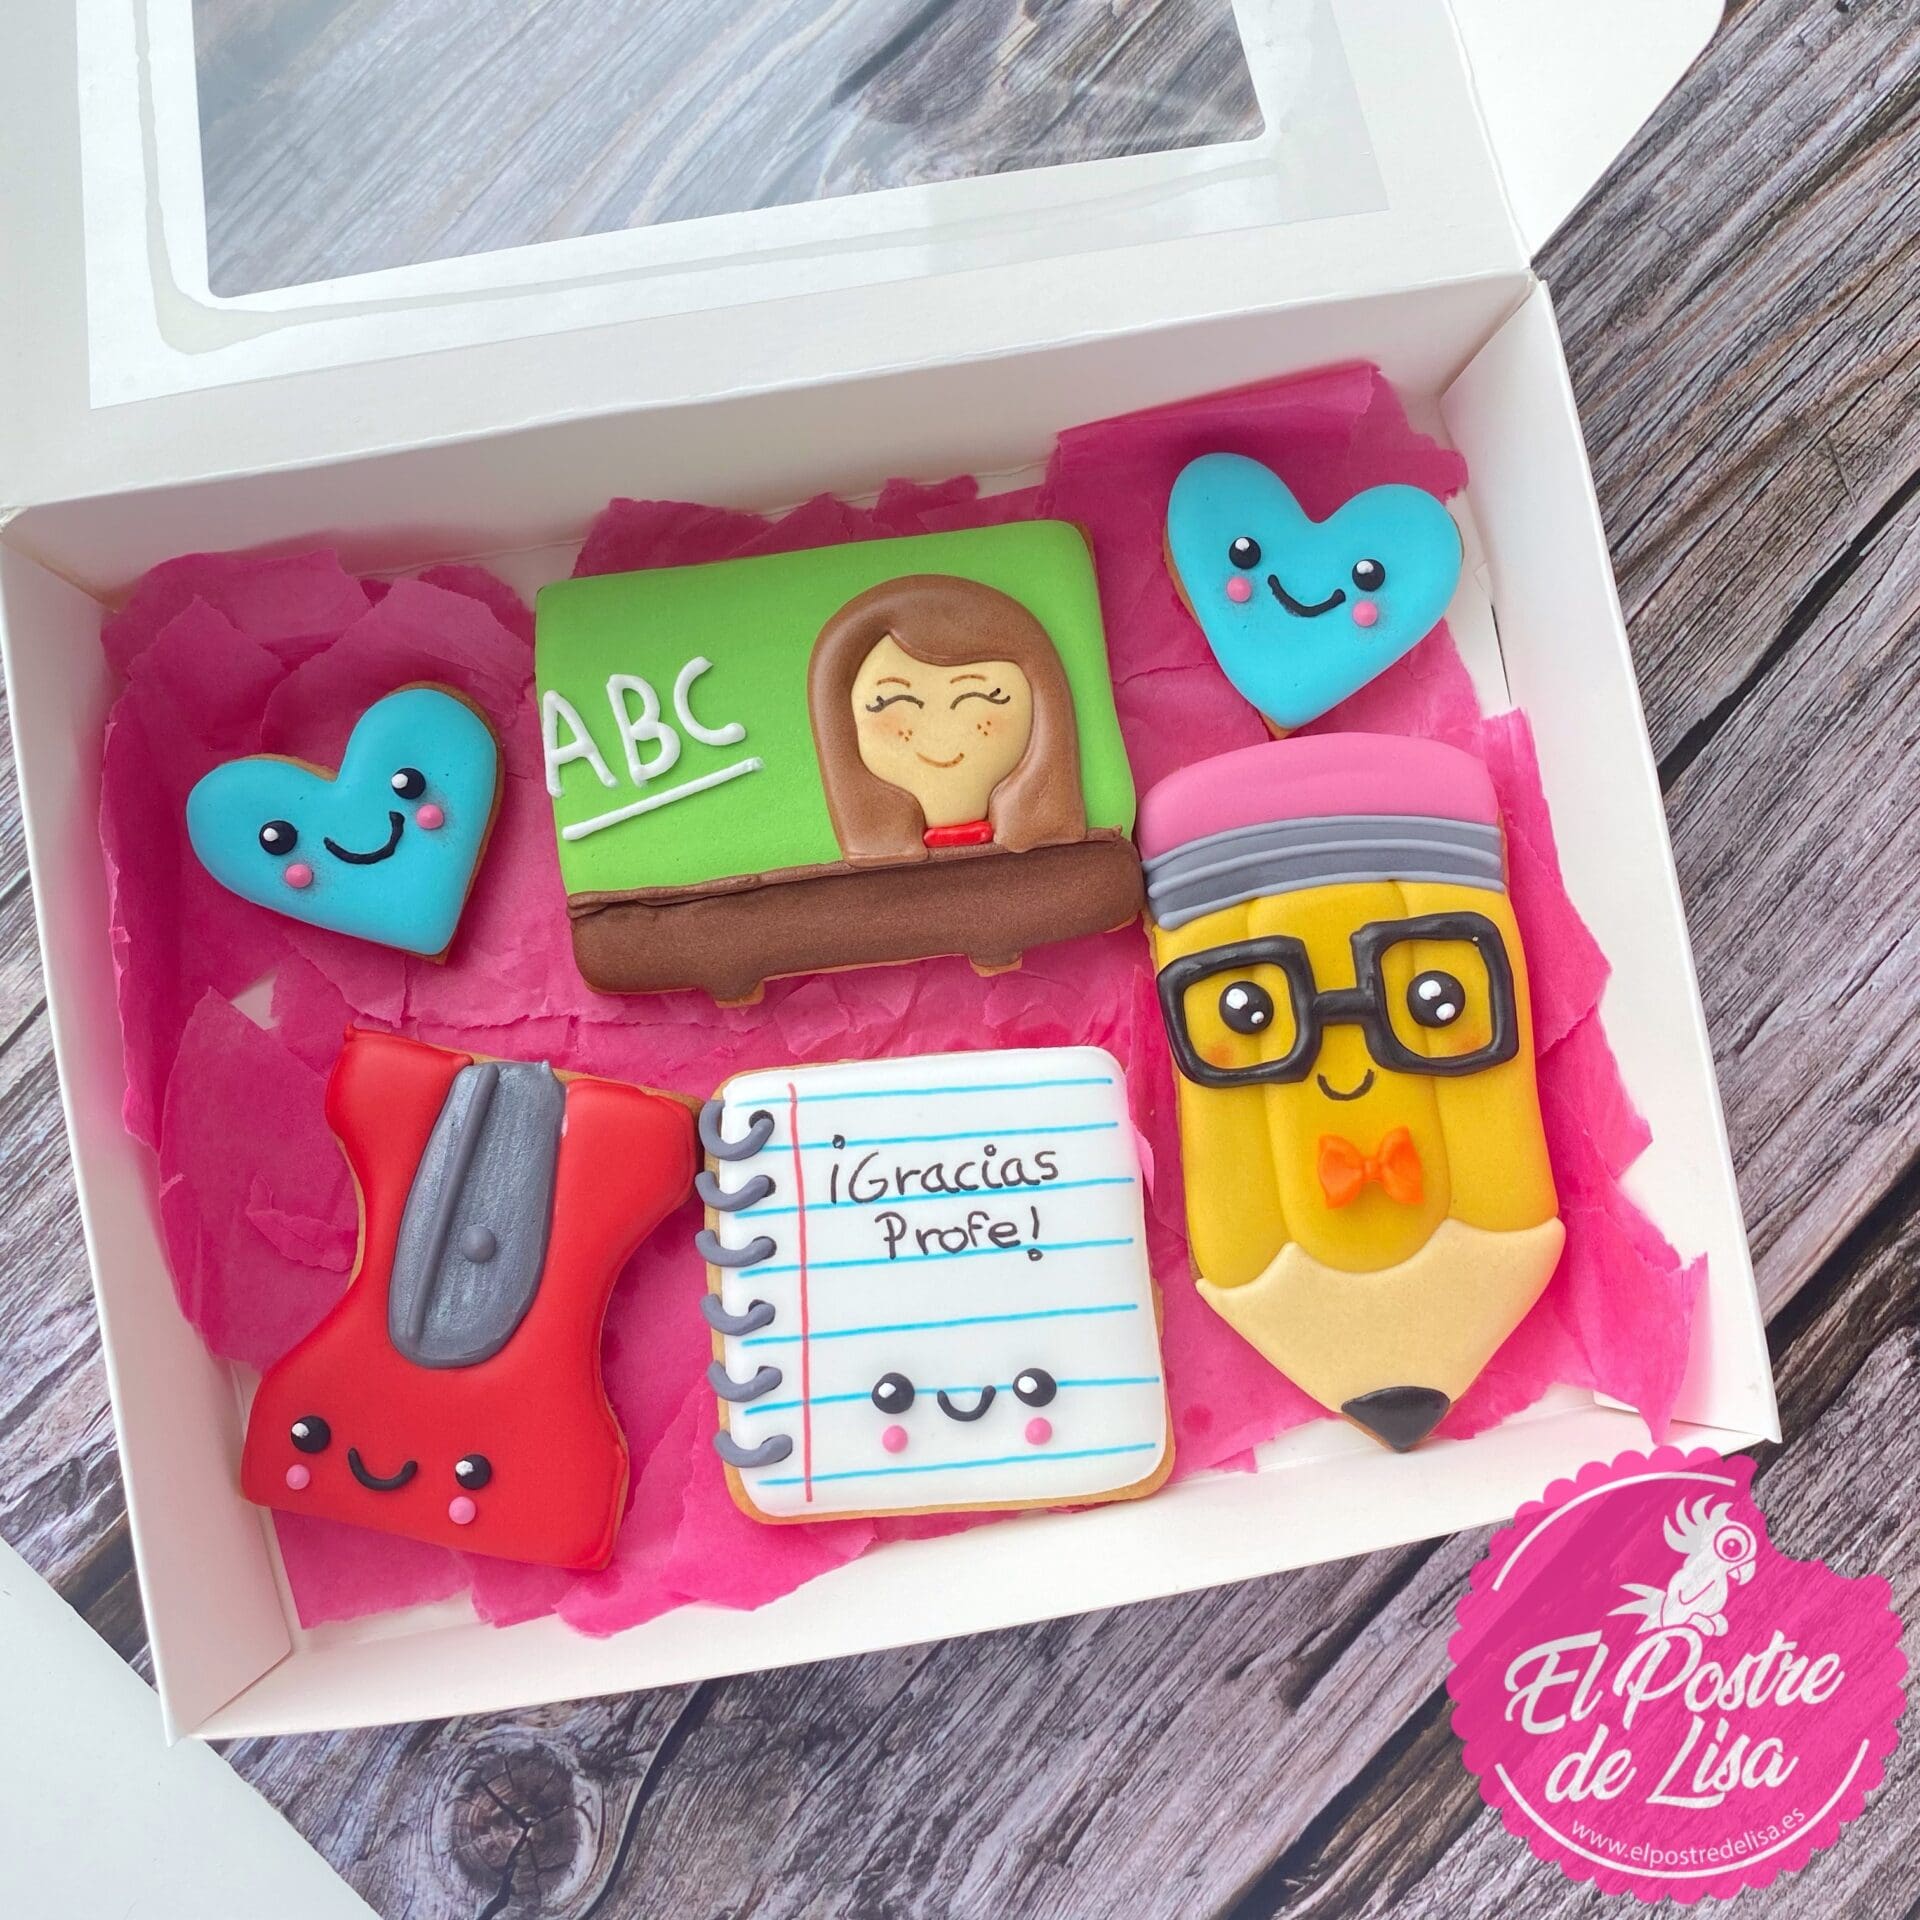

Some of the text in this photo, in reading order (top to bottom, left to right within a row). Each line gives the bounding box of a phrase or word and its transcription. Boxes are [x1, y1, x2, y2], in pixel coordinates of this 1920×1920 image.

[542, 655, 747, 799] ABC
[830, 1134, 1059, 1205] ¡Gracias
[874, 1205, 1043, 1262] Profe!
